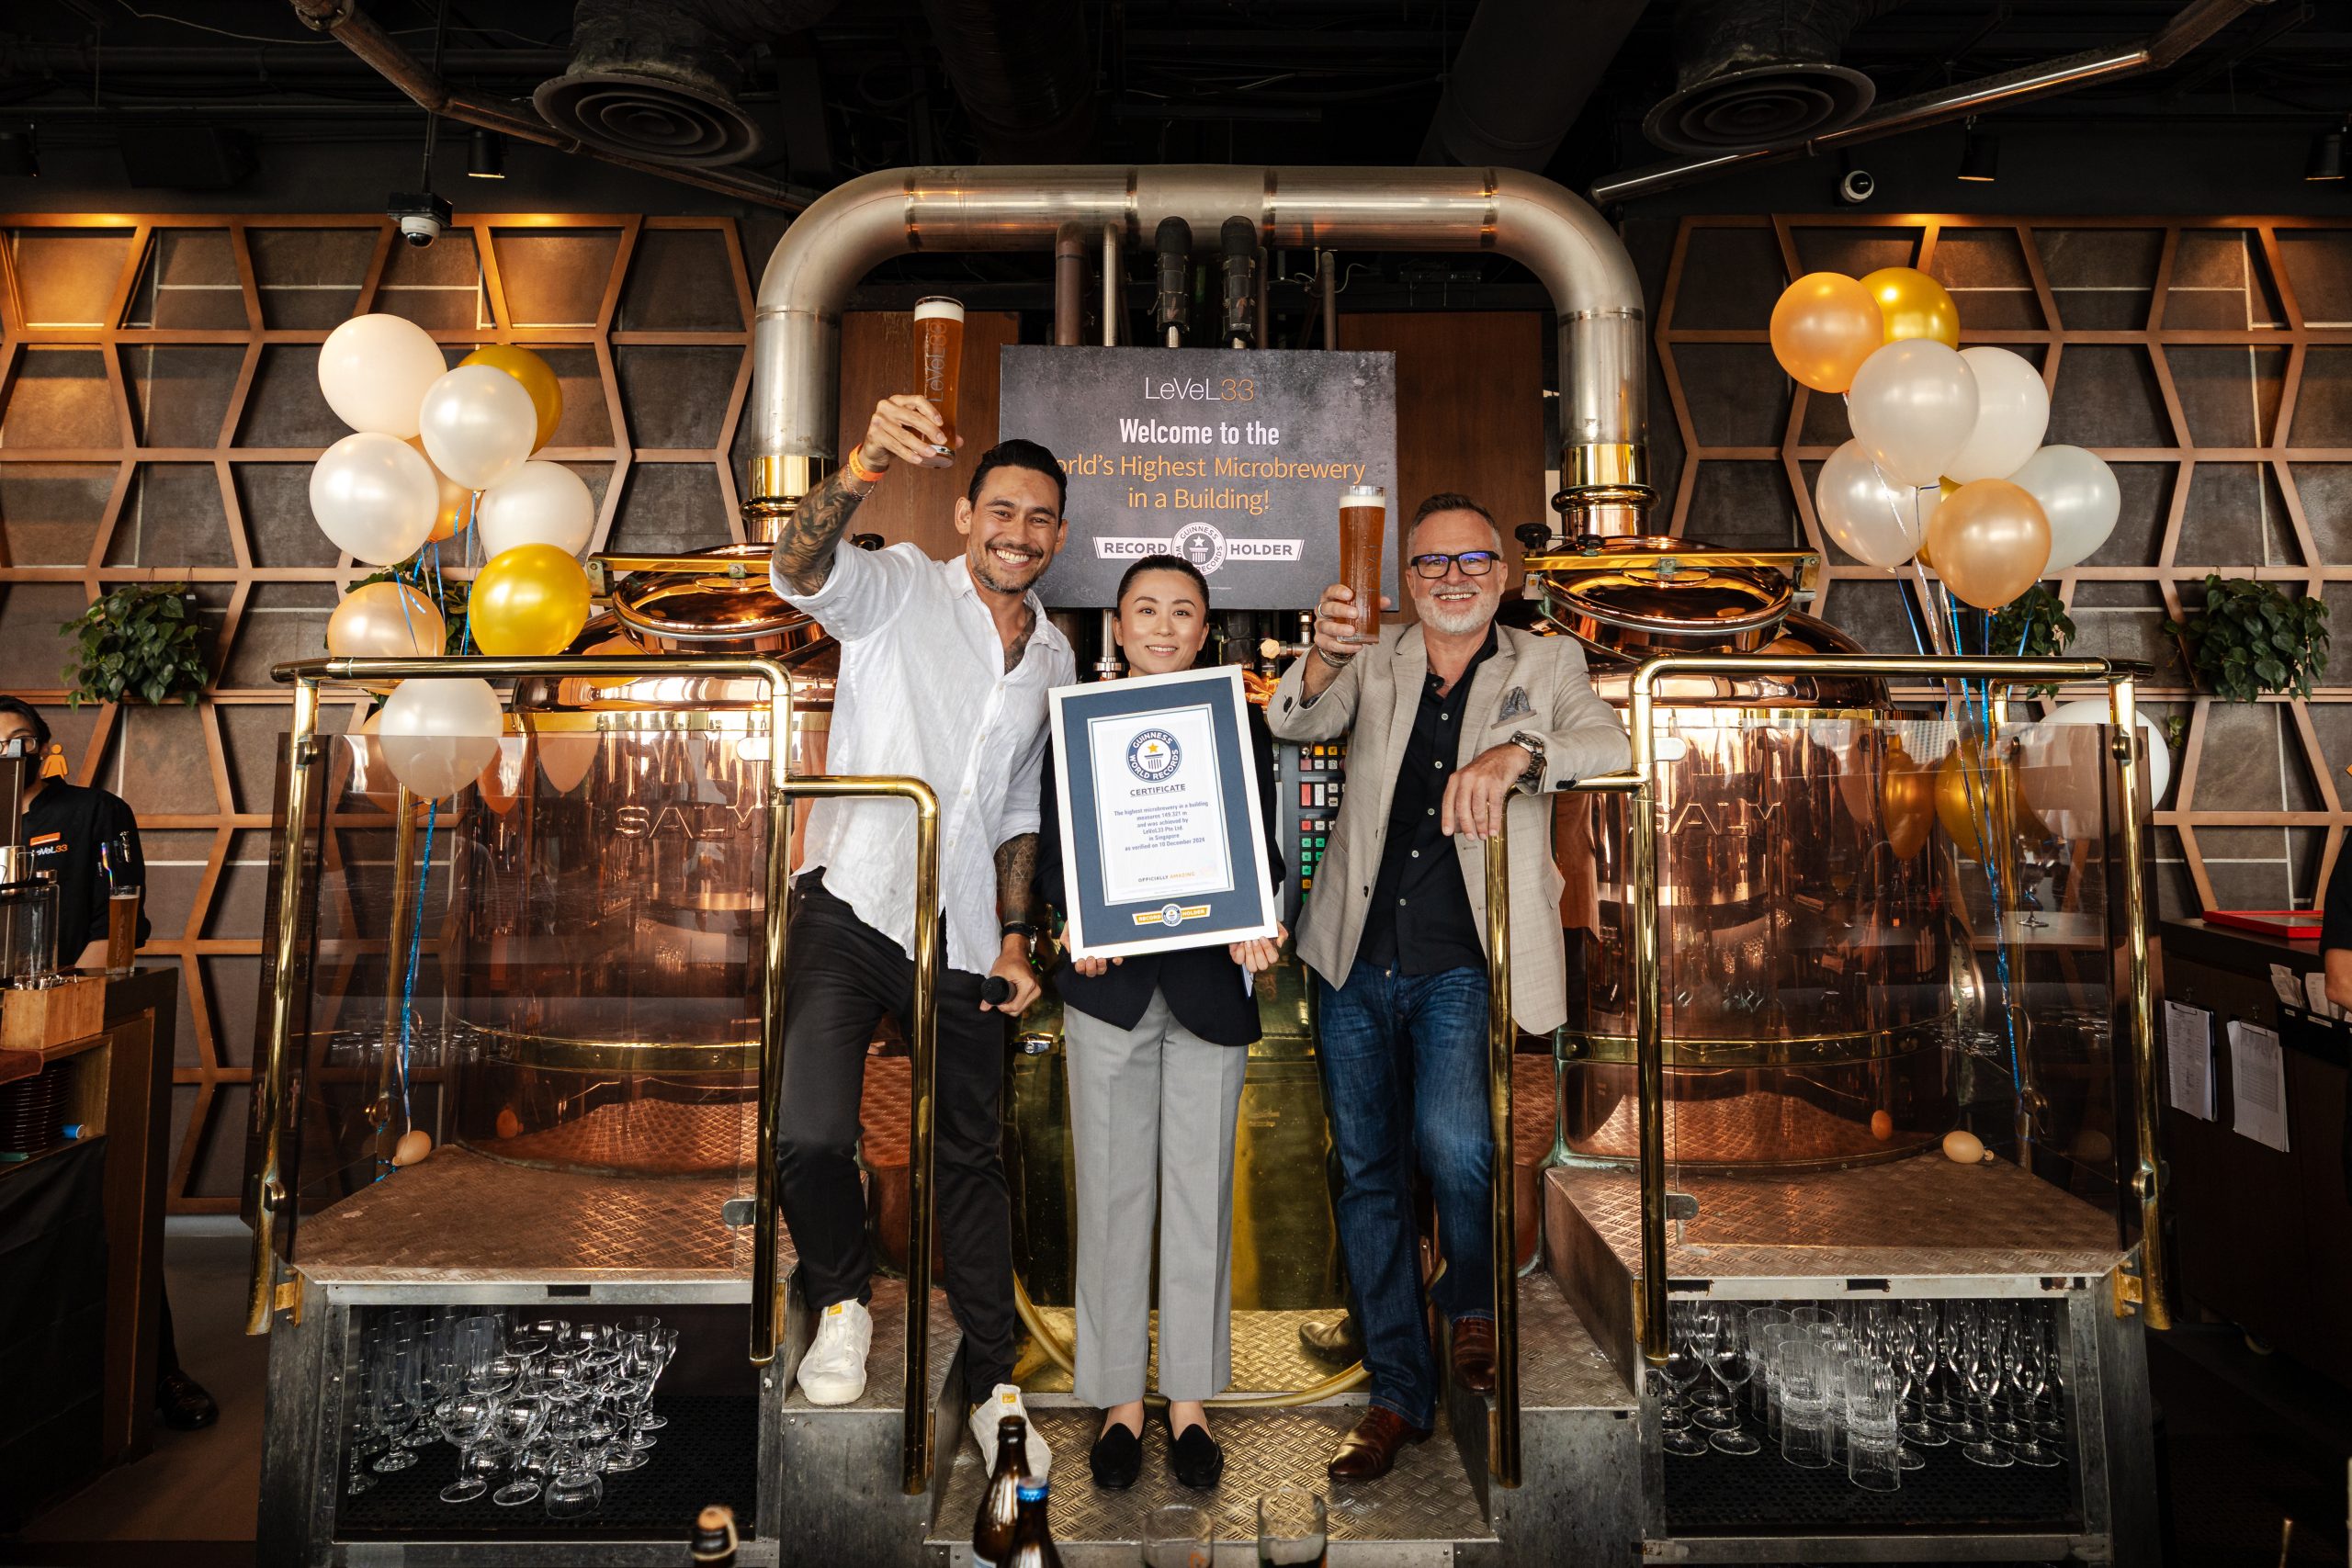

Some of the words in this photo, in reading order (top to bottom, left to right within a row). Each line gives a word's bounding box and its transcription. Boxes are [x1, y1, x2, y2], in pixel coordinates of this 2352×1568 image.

[1145, 377, 1254, 401] LeVeL33
[1120, 418, 1213, 444] Welcome
[1220, 422, 1239, 445] to
[1246, 421, 1279, 445] the
[1057, 455, 1114, 476] orld's
[1121, 456, 1205, 482] Highest
[1215, 457, 1365, 484] Microbrewery
[1128, 487, 1148, 508] in
[1154, 492, 1167, 508] a
[1174, 489, 1270, 515] Building!
[1180, 525, 1218, 540] GUINNESS
[1104, 542, 1167, 554] RECORD
[1231, 544, 1293, 555] HOLDER
[1132, 731, 1173, 749] GUINNESS
[1129, 754, 1150, 779] WORLD
[1153, 750, 1179, 779] RECORDS
[1130, 784, 1185, 796] CERTIFICATE
[1125, 808, 1143, 817] highest
[1144, 805, 1178, 814] microbrewery
[616, 806, 763, 839] SALM
[1159, 818, 1182, 827] achieved
[37, 844, 68, 856] eVeL33
[1167, 839, 1192, 847] December
